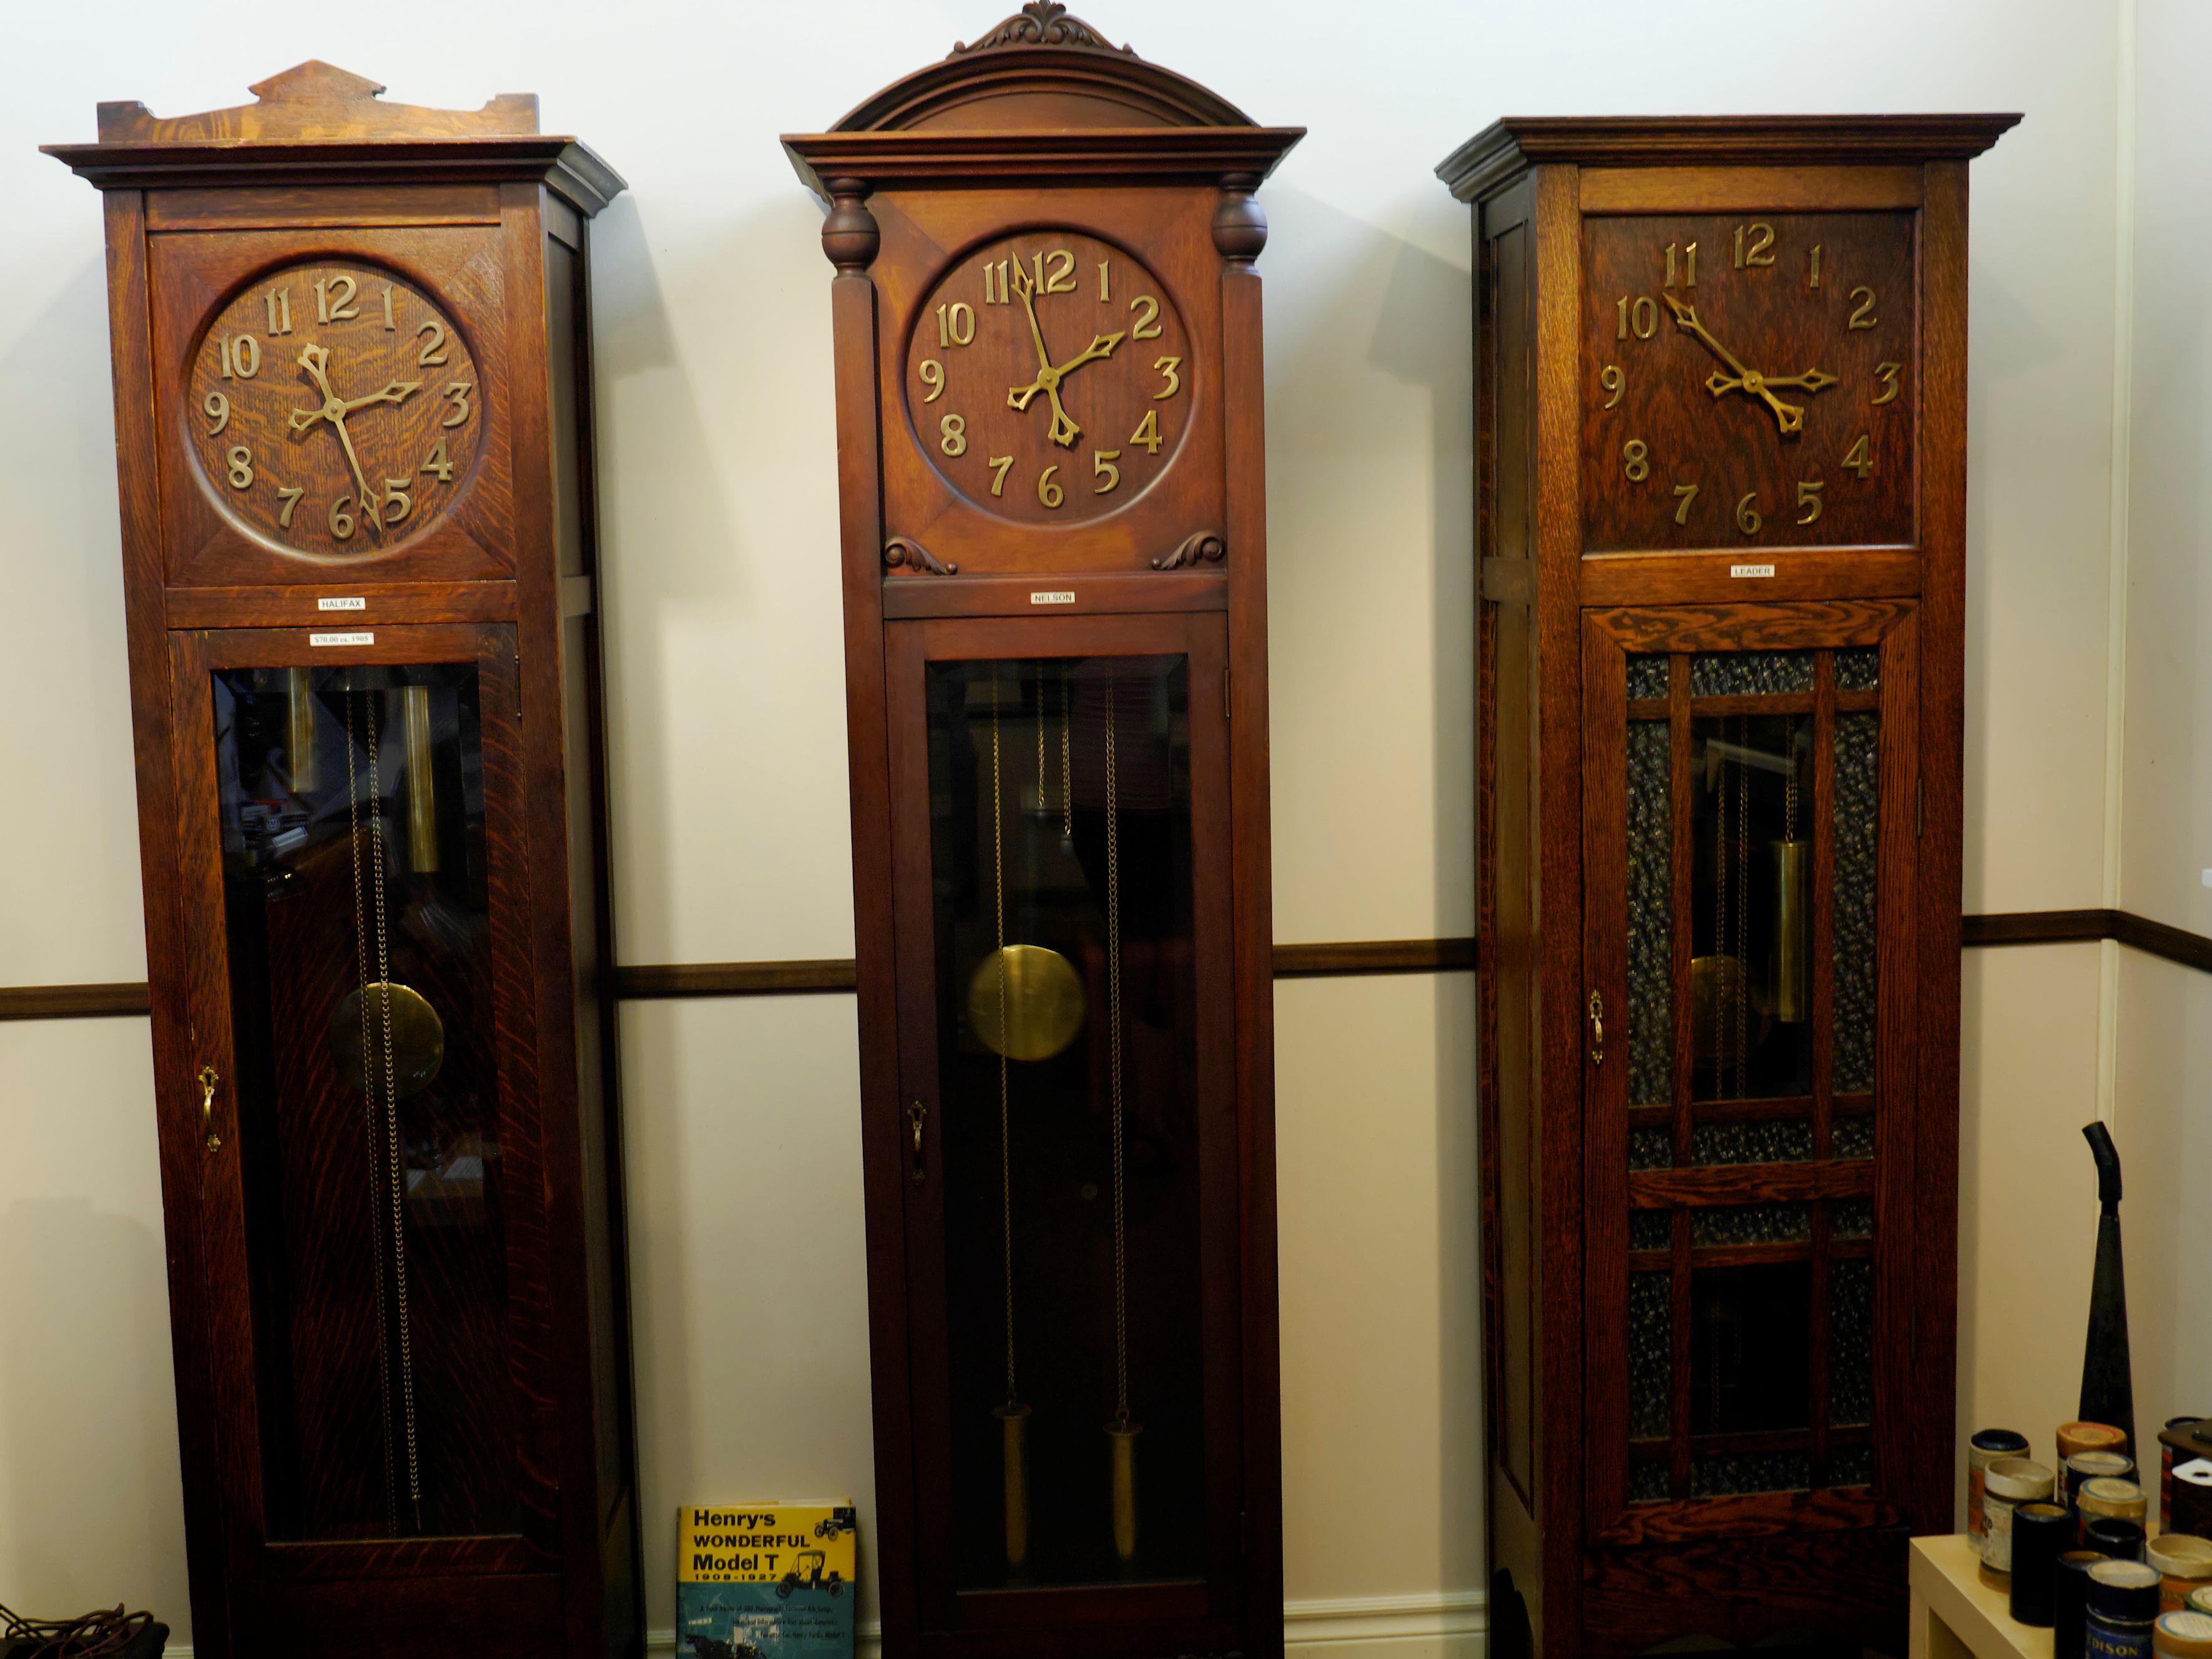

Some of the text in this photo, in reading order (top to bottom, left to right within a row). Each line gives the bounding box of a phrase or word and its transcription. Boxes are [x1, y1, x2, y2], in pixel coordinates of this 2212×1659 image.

[1665, 242, 1696, 288] 11
[1734, 224, 1774, 270] 12
[1809, 244, 1820, 288] 1
[983, 260, 1010, 303] 11
[1032, 249, 1076, 294] 12
[1098, 260, 1110, 302] 1
[265, 288, 293, 335] 11
[314, 275, 360, 325] 12
[382, 285, 396, 331] 1
[1131, 295, 1162, 340] 2
[1617, 295, 1658, 340] 10
[1849, 286, 1876, 330] 2
[417, 322, 448, 367] 2
[936, 302, 976, 348] 10
[219, 334, 260, 380] 10
[1153, 357, 1182, 400] 3
[919, 360, 945, 402] 9
[1601, 365, 1625, 408] 9
[1872, 361, 1902, 405] 3
[204, 392, 230, 435] 9
[442, 383, 472, 426] 3
[940, 414, 966, 456] 8
[1129, 410, 1163, 454] 4
[227, 446, 253, 489] 8
[420, 436, 453, 481] 4
[989, 456, 1014, 496] 7
[1094, 450, 1121, 493] 5
[1623, 440, 1649, 483] 8
[1841, 435, 1873, 478] 4
[277, 488, 304, 528] 7
[385, 478, 411, 523] 5
[1038, 466, 1064, 508] 6
[1674, 485, 1699, 524] 7
[1797, 481, 1823, 524] 5
[329, 496, 355, 539] 6
[1737, 493, 1762, 535] 6
[1035, 593, 1071, 601] NELSON
[694, 1510, 775, 1529] Henry's
[694, 1535, 810, 1547] WONDERFUL
[693, 1554, 779, 1570] Model T
